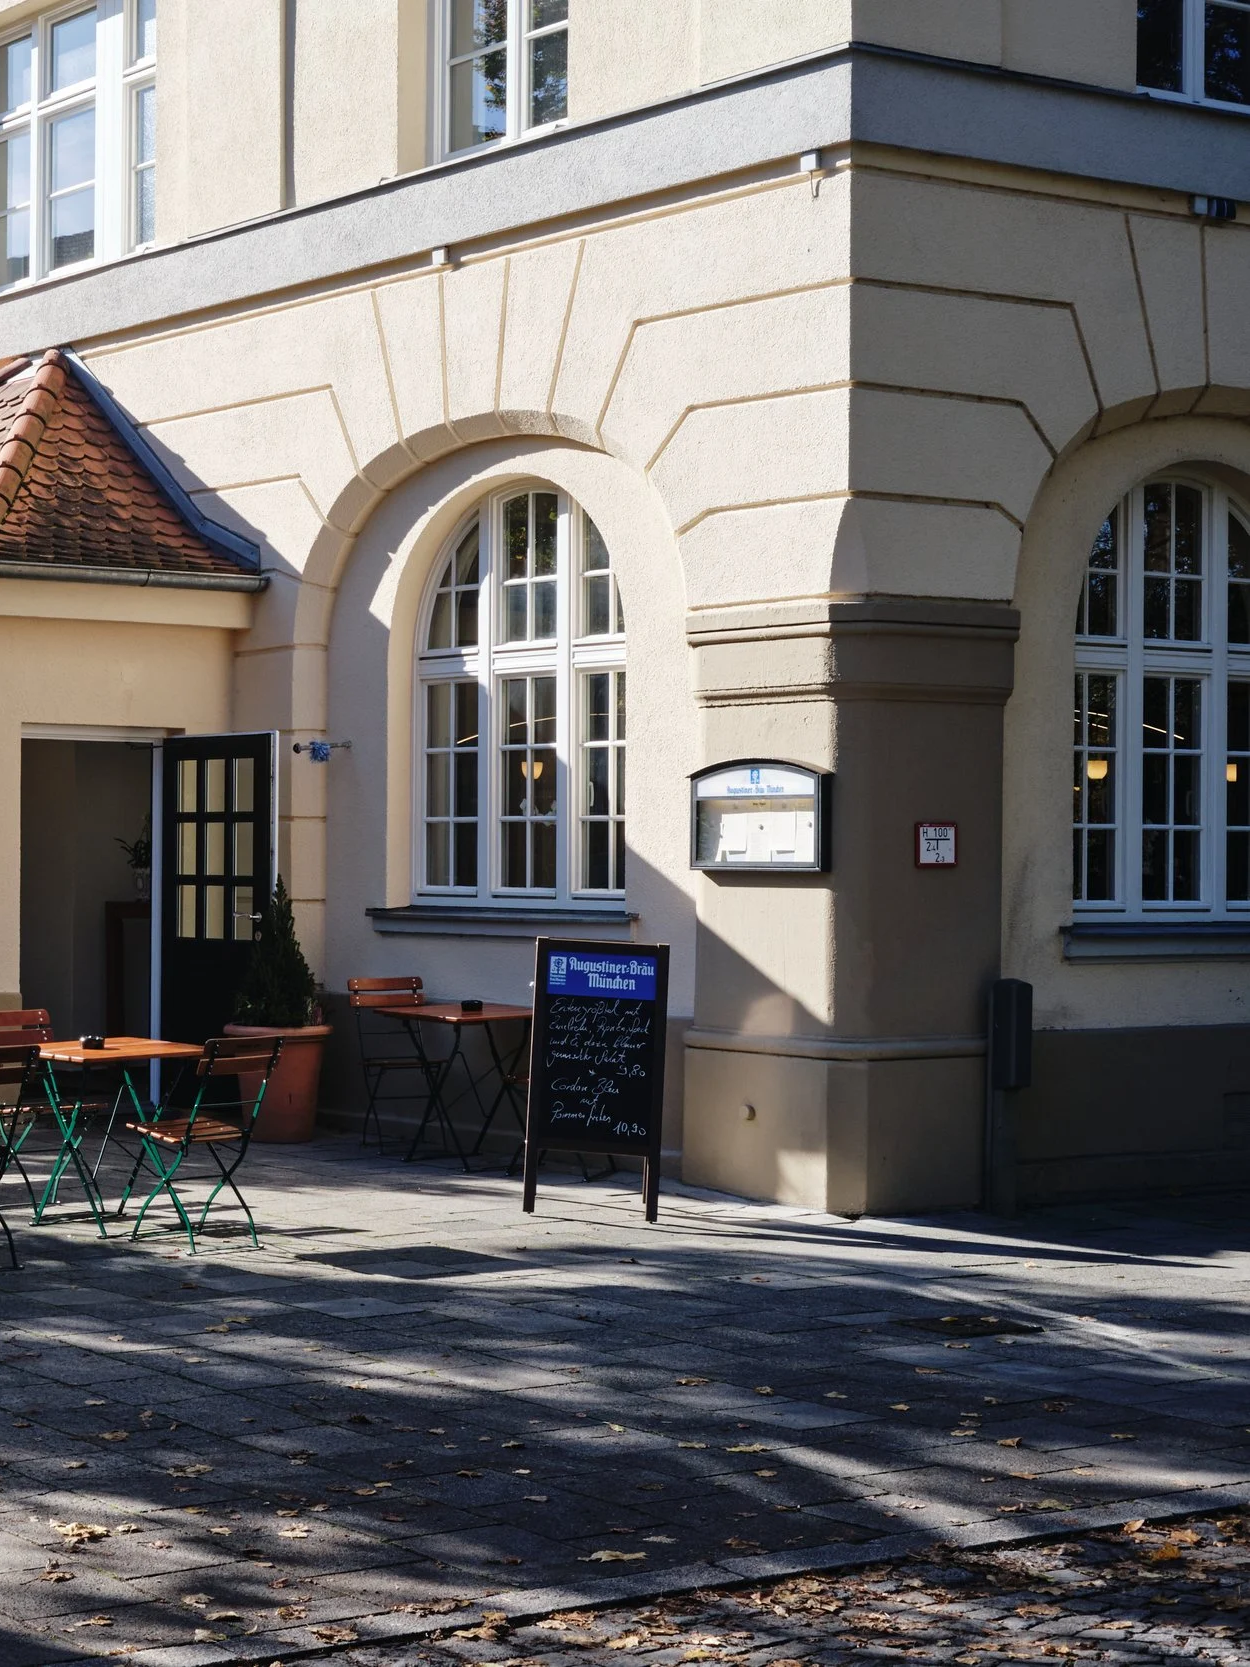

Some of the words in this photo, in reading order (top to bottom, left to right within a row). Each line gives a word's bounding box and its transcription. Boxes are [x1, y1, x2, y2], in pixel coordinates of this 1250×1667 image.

[922, 828, 928, 837] H
[934, 828, 948, 837] 100
[588, 973, 636, 990] München
[625, 1002, 642, 1015] mit
[549, 1034, 569, 1045] und
[595, 1050, 626, 1065] Salat
[616, 1064, 646, 1078] 9,80
[551, 1077, 588, 1091] Cordon
[591, 1078, 619, 1094] Bleu
[580, 1094, 600, 1105] mit
[613, 1121, 647, 1136] 10,90
